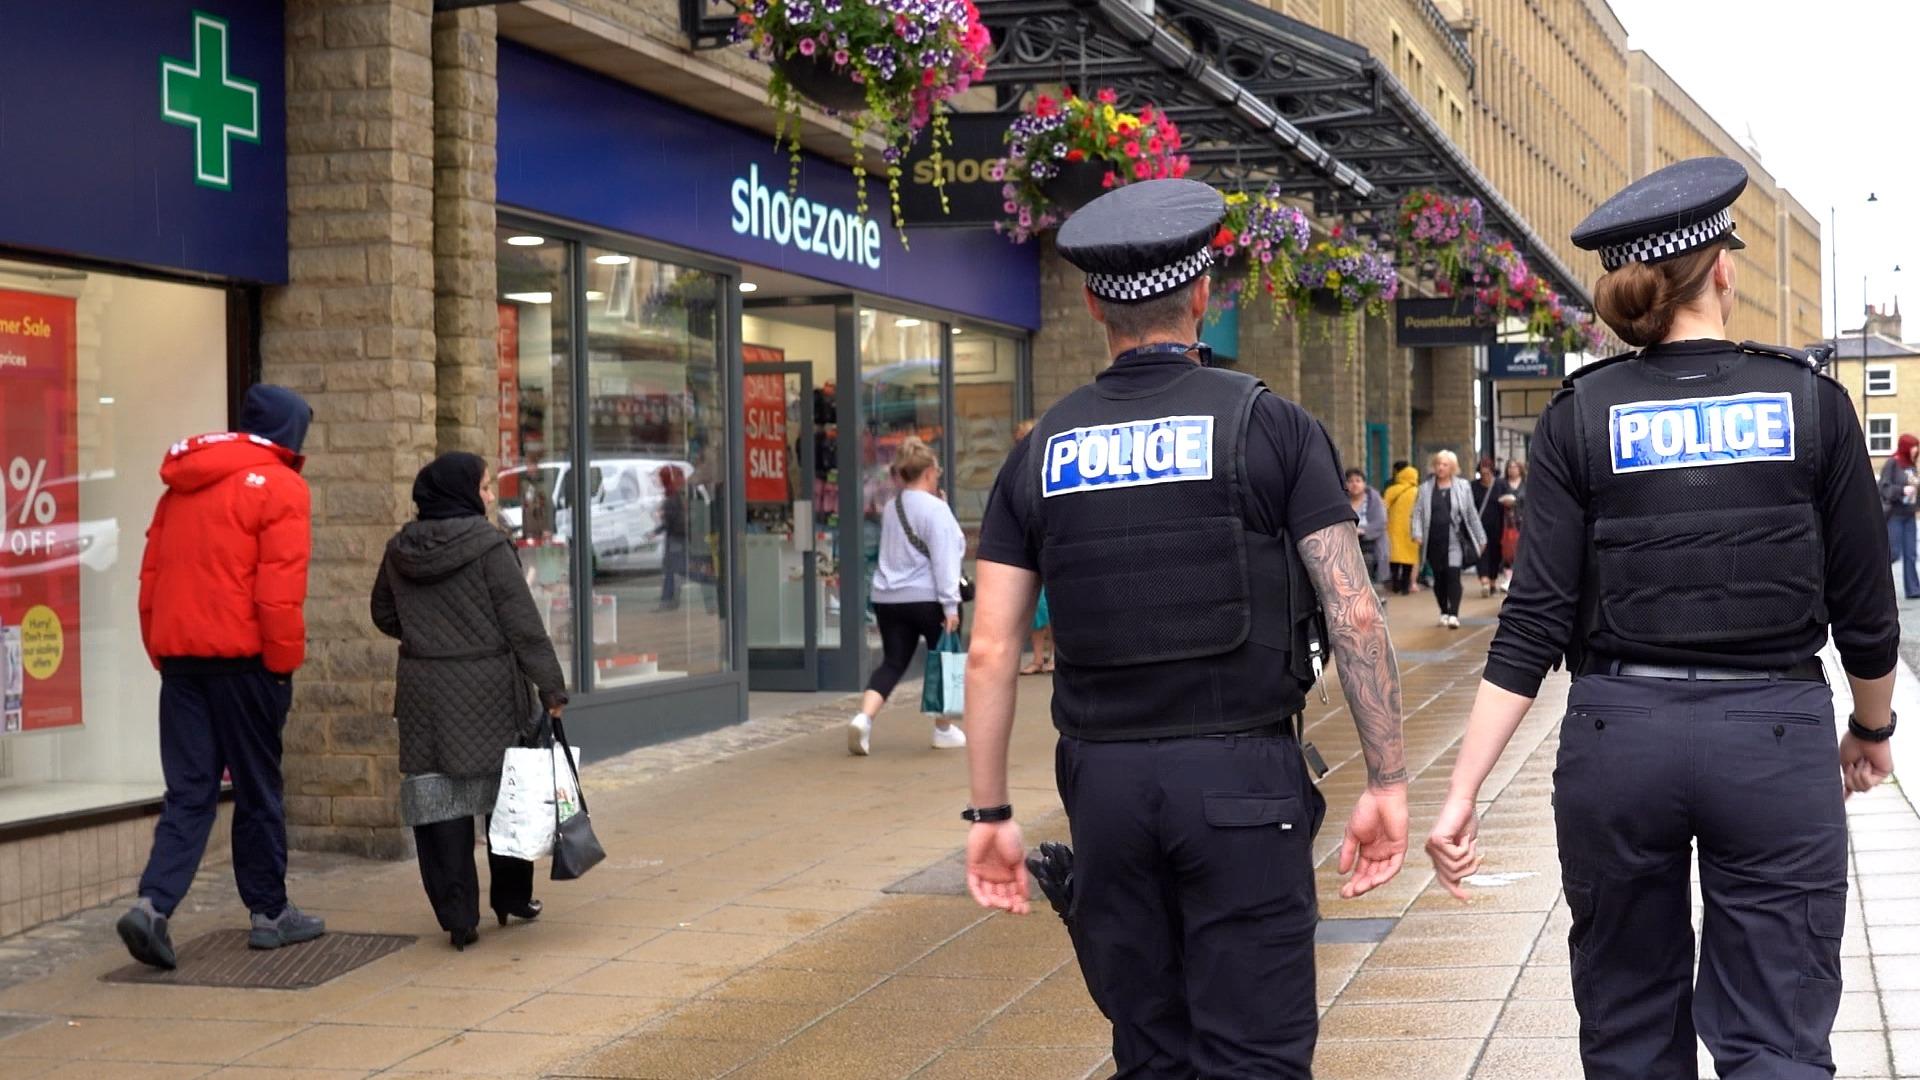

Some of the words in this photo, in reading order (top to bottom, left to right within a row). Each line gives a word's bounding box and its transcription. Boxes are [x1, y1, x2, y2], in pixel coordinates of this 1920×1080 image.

[731, 162, 881, 269] shoezone
[23, 315, 51, 338] Sale
[1405, 315, 1471, 328] Poundland
[748, 407, 782, 441] SALE
[1619, 403, 1785, 459] POLICE
[750, 448, 784, 479] SALE
[1050, 425, 1202, 483] POLICE
[11, 530, 57, 556] OFF
